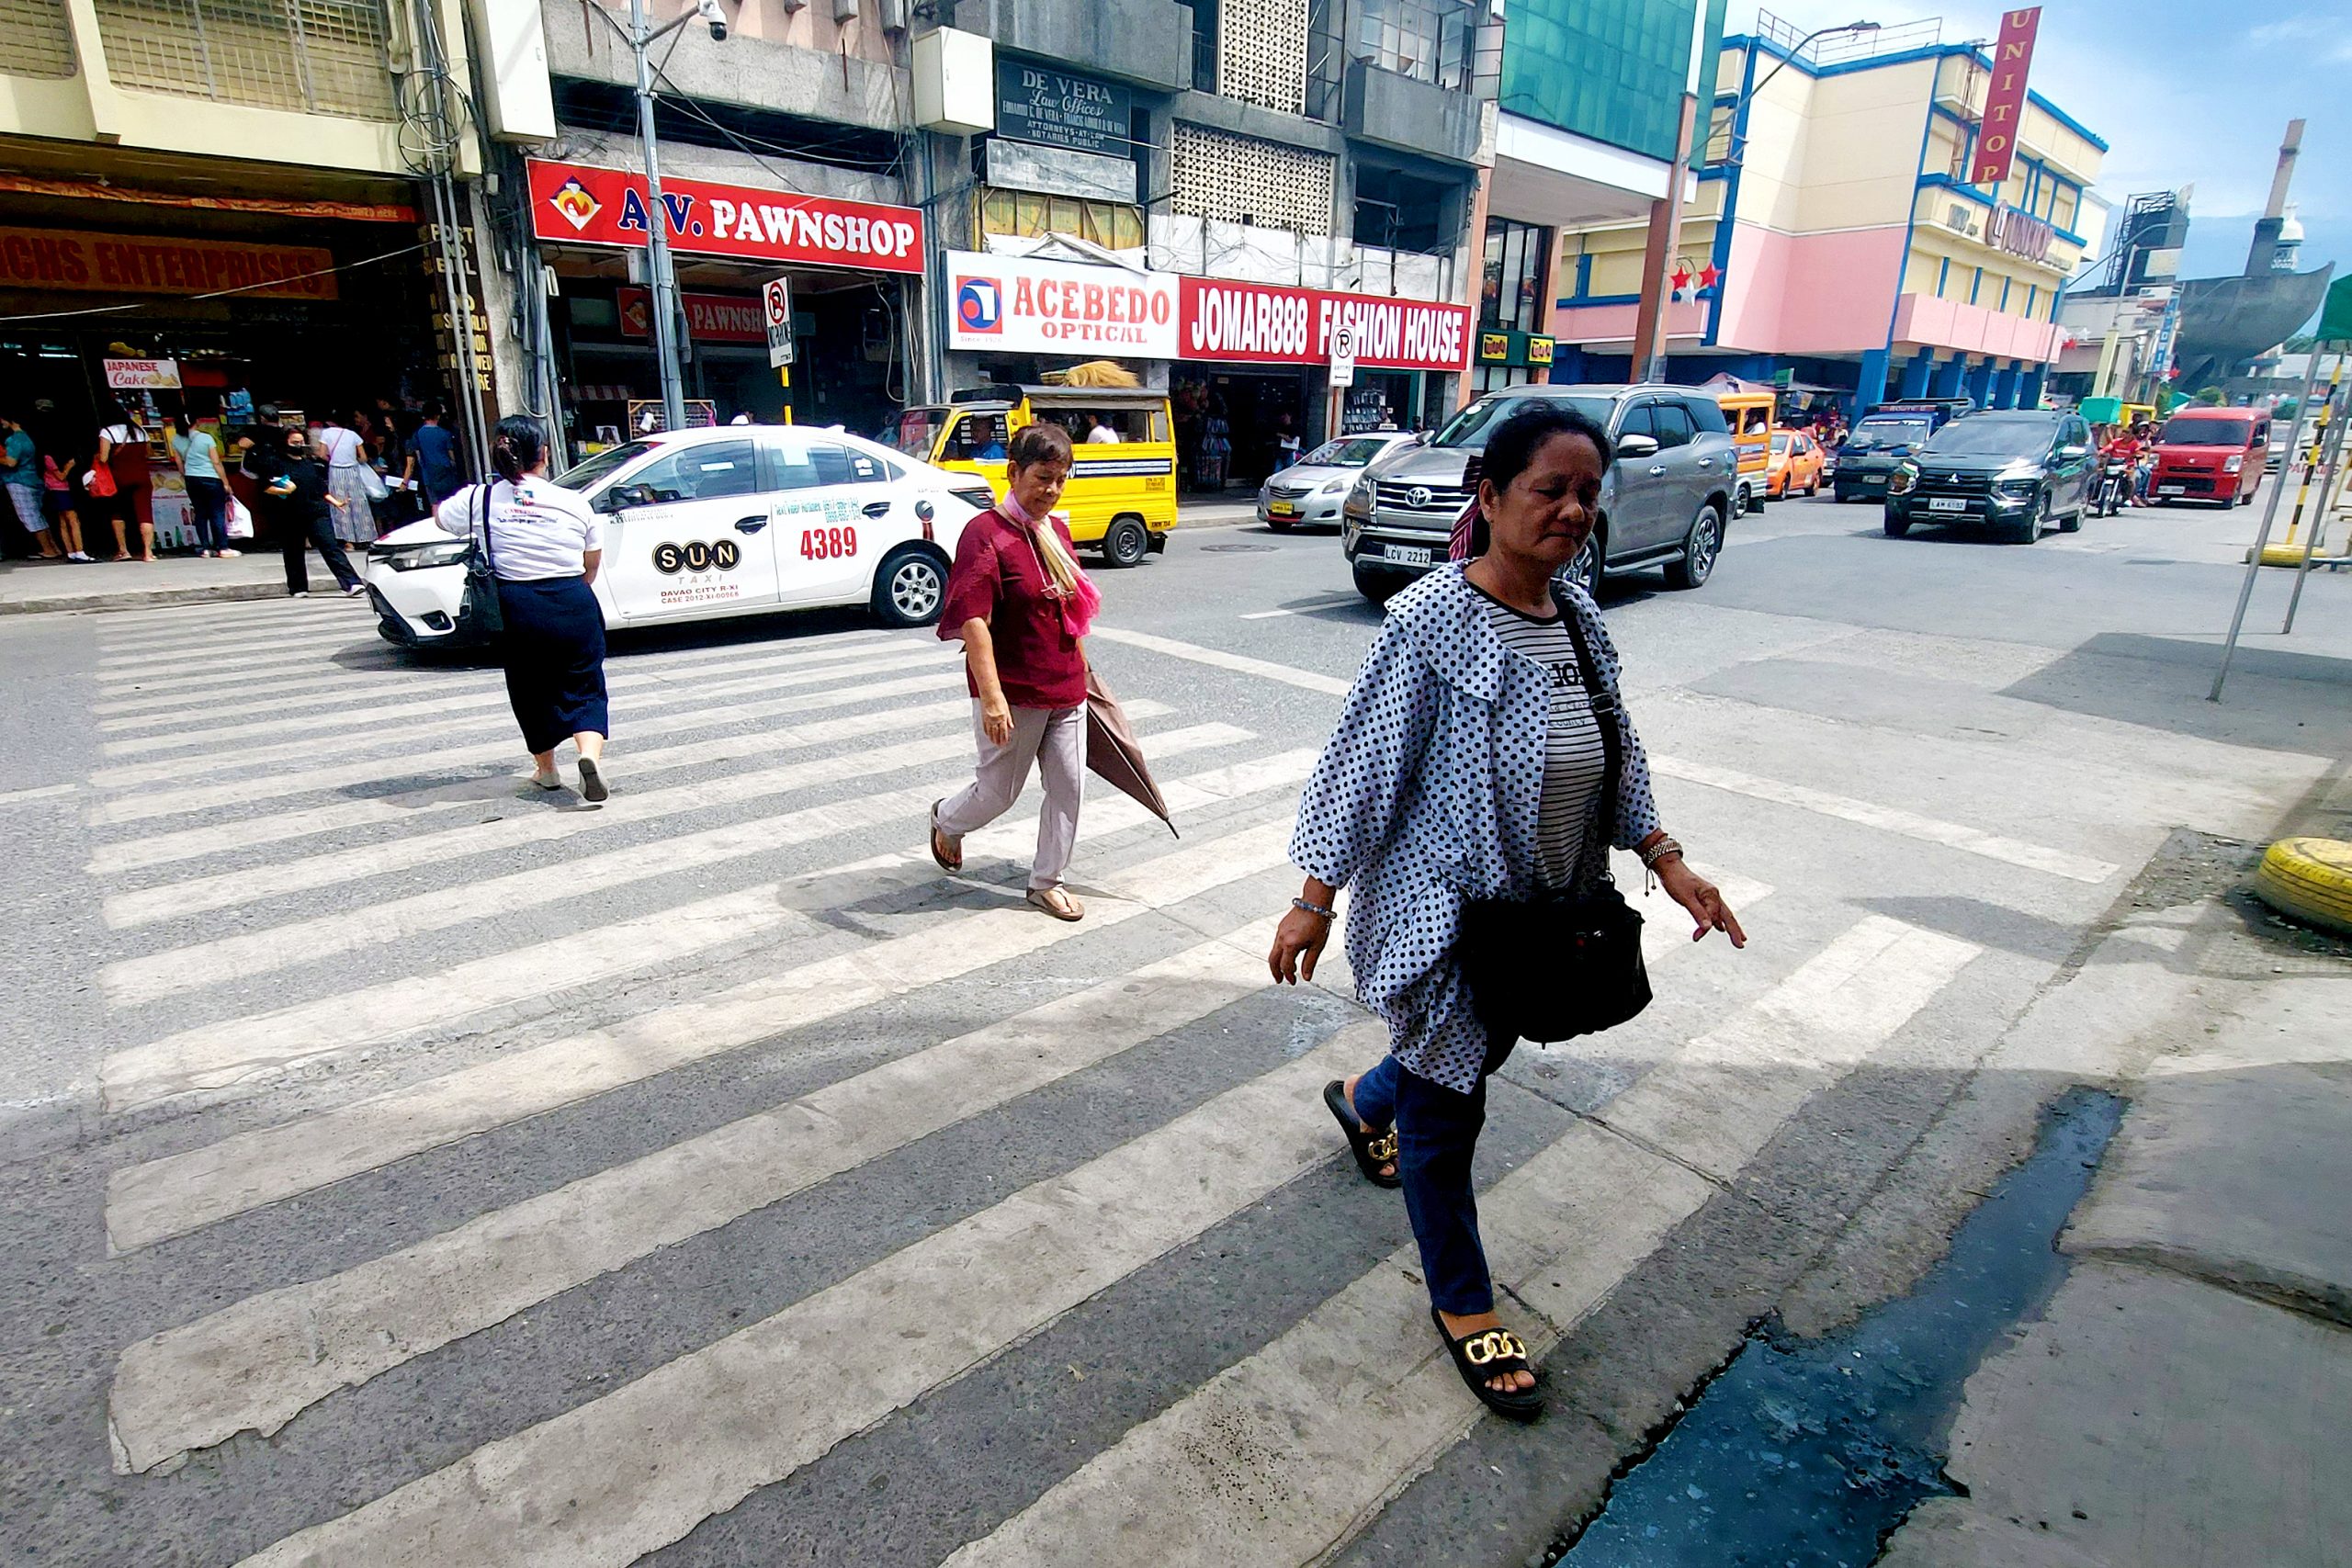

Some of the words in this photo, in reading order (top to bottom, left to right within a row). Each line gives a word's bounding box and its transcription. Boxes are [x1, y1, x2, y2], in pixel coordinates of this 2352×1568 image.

[1022, 70, 1049, 91] DE
[1056, 76, 1114, 105] VERA
[1981, 10, 2033, 182] UNITOP
[1029, 89, 1061, 107] Law
[1062, 96, 1104, 117] Offices
[1032, 130, 1069, 143] NOTARIES
[1072, 137, 1101, 148] PUBLIC
[708, 198, 915, 258] PAWNSHOP
[95, 242, 318, 296] ENTERPRISES
[1013, 276, 1170, 325] ACEBEDO
[1041, 321, 1148, 344] OPTICAL
[1191, 288, 1309, 356] JOMAR888
[1317, 299, 1402, 360] FASHION
[1403, 307, 1464, 364] HOUSE
[107, 362, 159, 372] JAPANESE
[113, 372, 147, 386] Cake
[800, 526, 857, 560] 4389
[661, 544, 735, 569] SUN
[1385, 548, 1402, 561] LCV
[1407, 551, 1430, 564] 2212
[661, 588, 693, 597] DAVAO
[695, 585, 718, 594] CITY
[677, 573, 723, 585] TAXI
[661, 595, 684, 604] CASE
